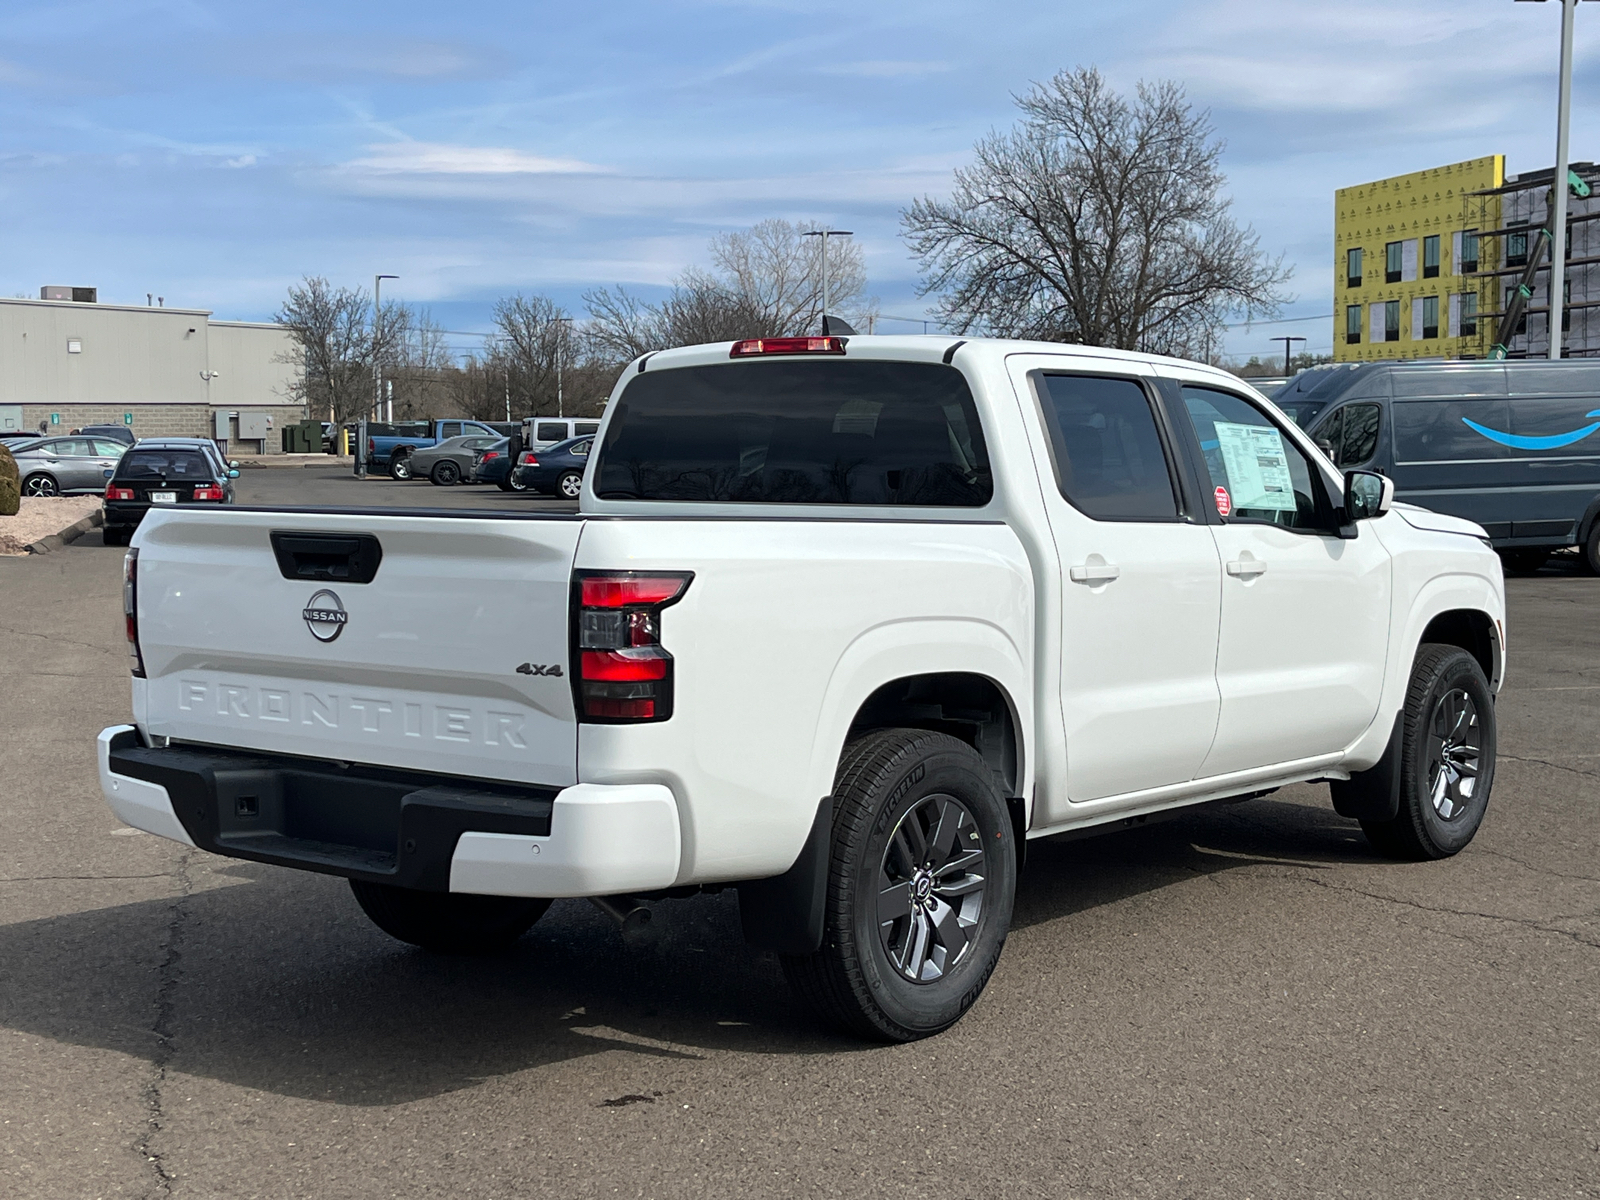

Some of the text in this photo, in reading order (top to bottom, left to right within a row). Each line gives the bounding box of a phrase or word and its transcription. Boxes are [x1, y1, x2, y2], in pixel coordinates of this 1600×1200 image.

[303, 610, 346, 622] NISSAN
[179, 679, 527, 749] FRONTIER
[878, 764, 925, 833] MICHELIN
